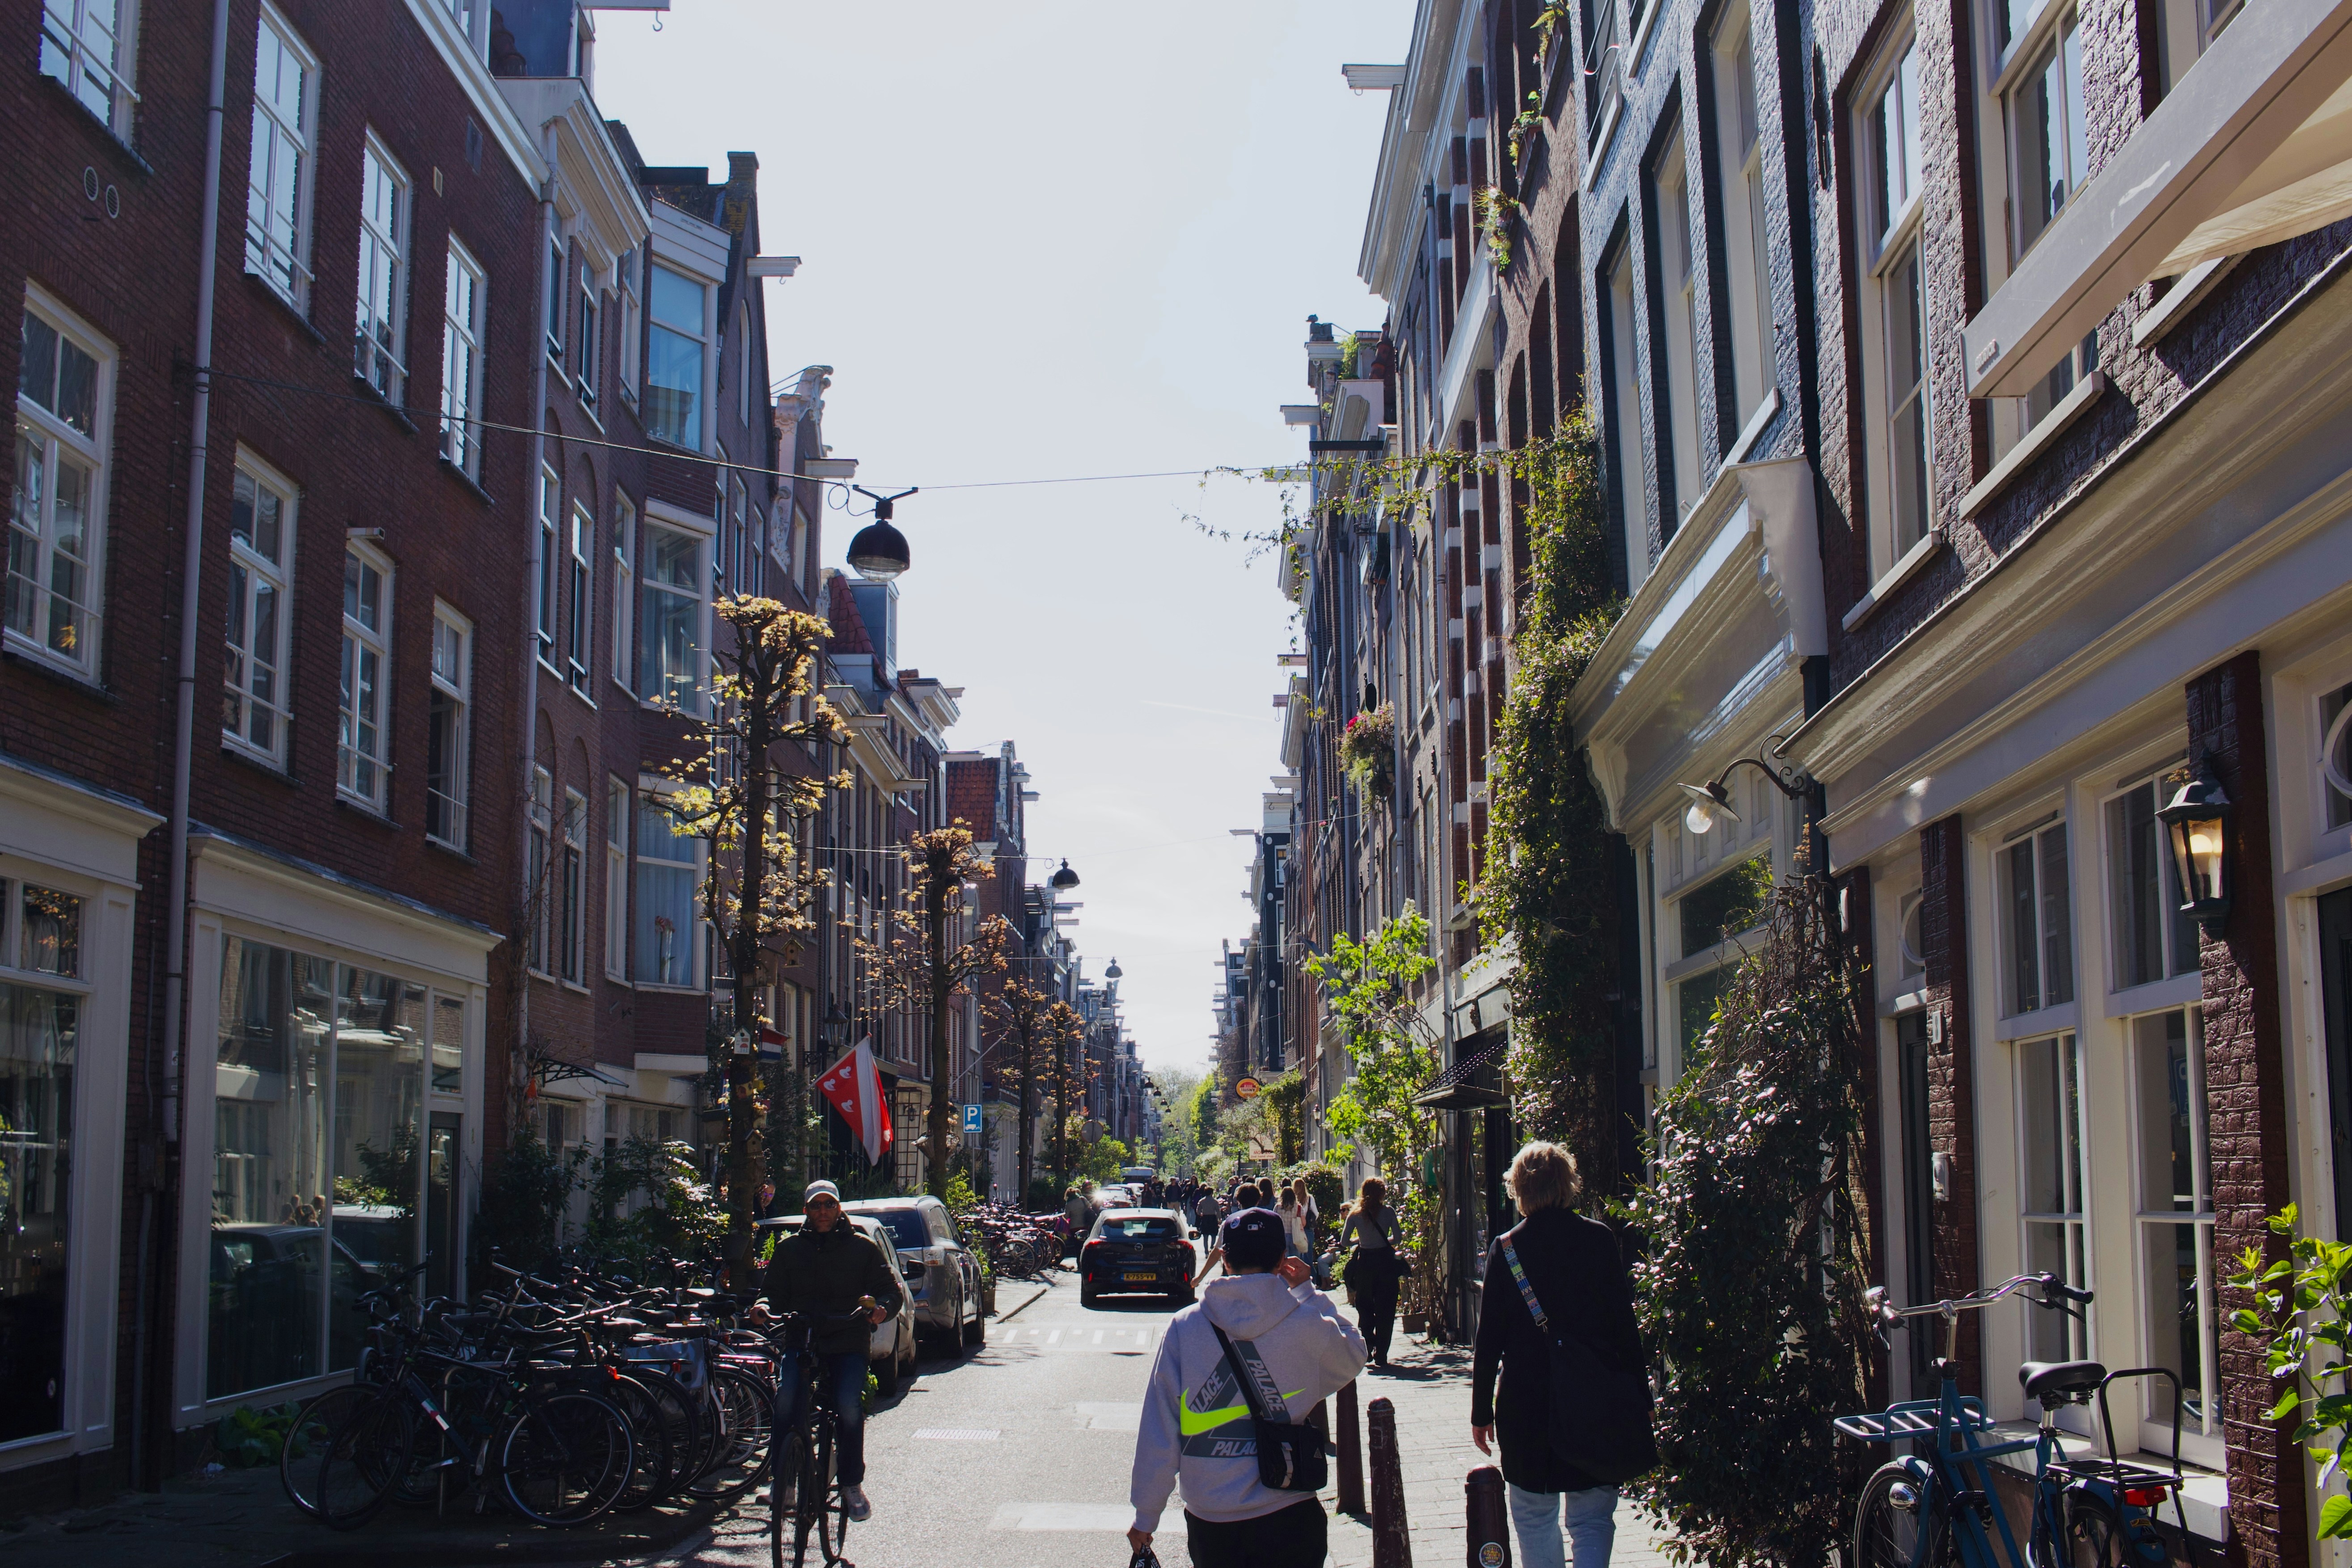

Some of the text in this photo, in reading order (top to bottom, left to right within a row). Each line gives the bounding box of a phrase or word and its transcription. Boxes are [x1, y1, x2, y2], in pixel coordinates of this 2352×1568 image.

[967, 1107, 978, 1121] P
[1190, 1370, 1224, 1413] ALACE
[1246, 1359, 1286, 1412] PALACE
[1210, 1441, 1258, 1456] PALAC
